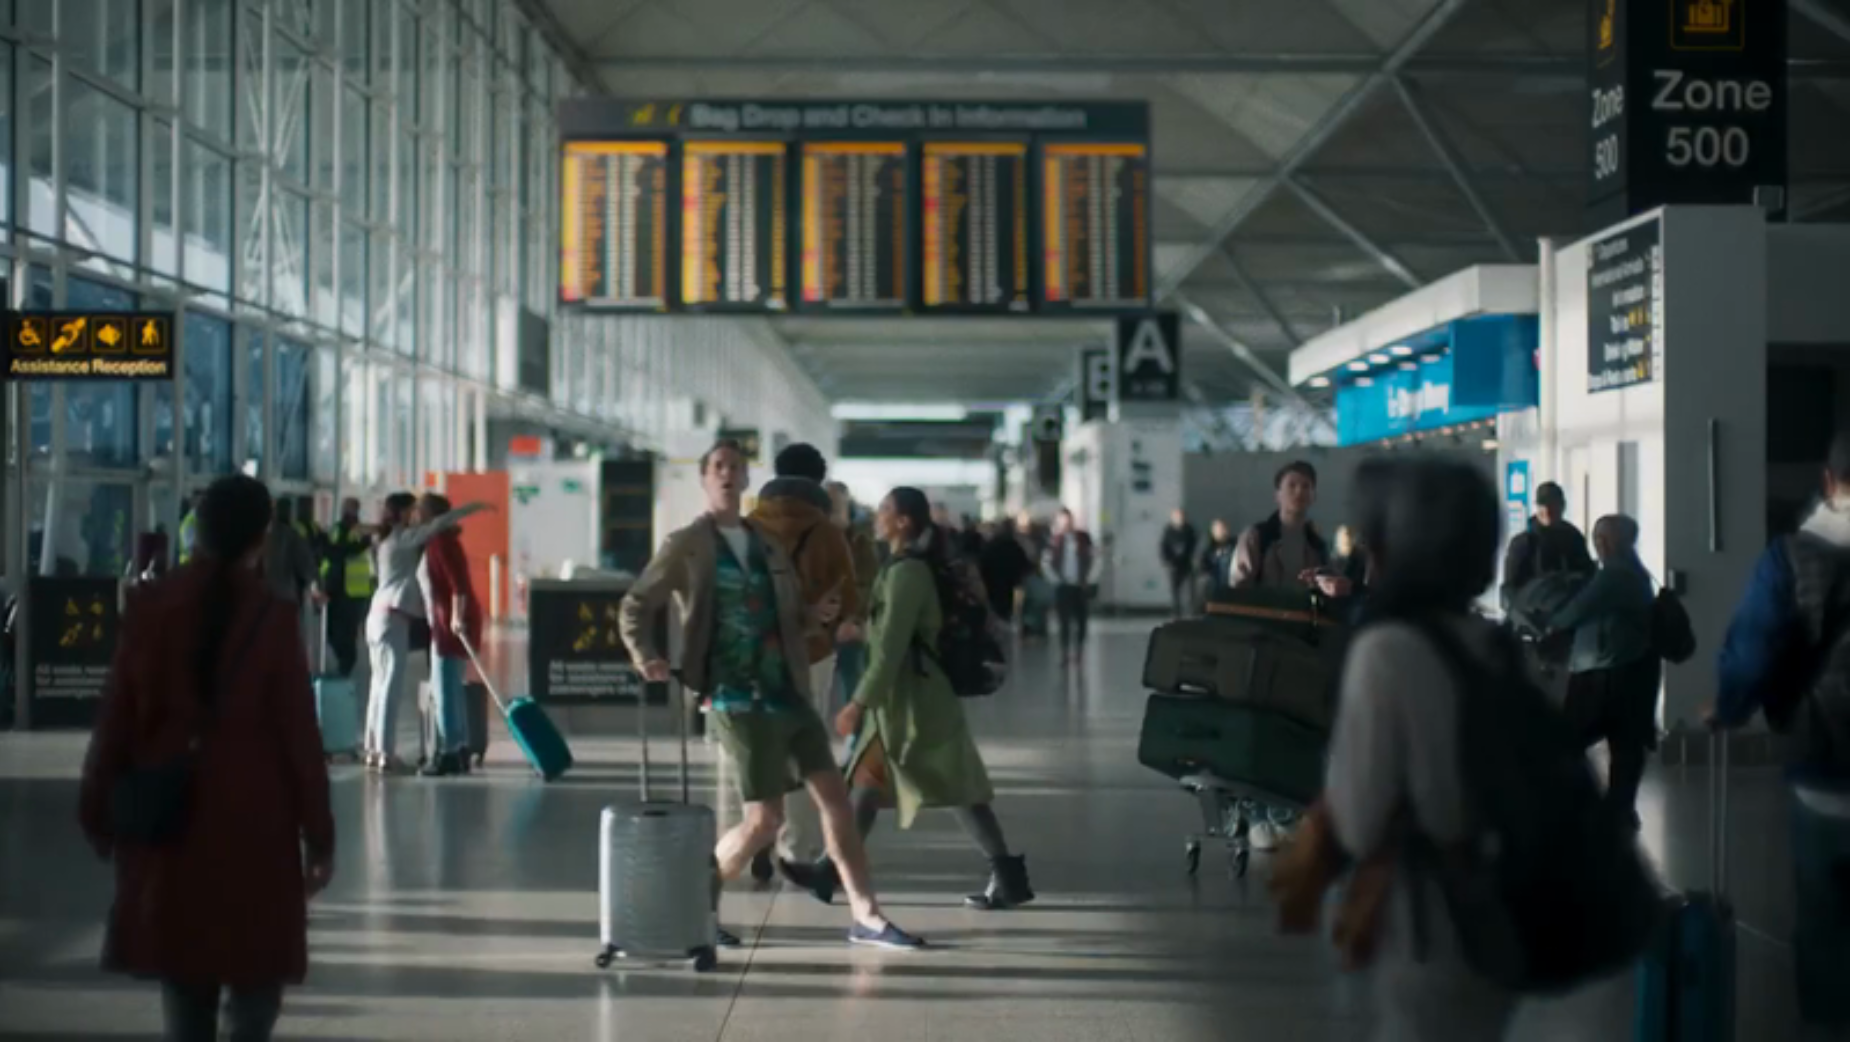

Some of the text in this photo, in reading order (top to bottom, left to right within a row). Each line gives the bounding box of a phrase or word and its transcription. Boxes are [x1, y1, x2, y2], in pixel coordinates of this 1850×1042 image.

[1591, 84, 1624, 128] Zone
[1652, 70, 1772, 110] Zone
[690, 103, 739, 131] Bag
[741, 104, 799, 131] Drop
[803, 104, 848, 128] and
[851, 104, 925, 128] Check
[956, 104, 1087, 129] Information
[1595, 134, 1619, 179] 500
[1666, 127, 1749, 166] 500
[1123, 319, 1174, 373] A
[11, 359, 166, 376] Assistance Reception
